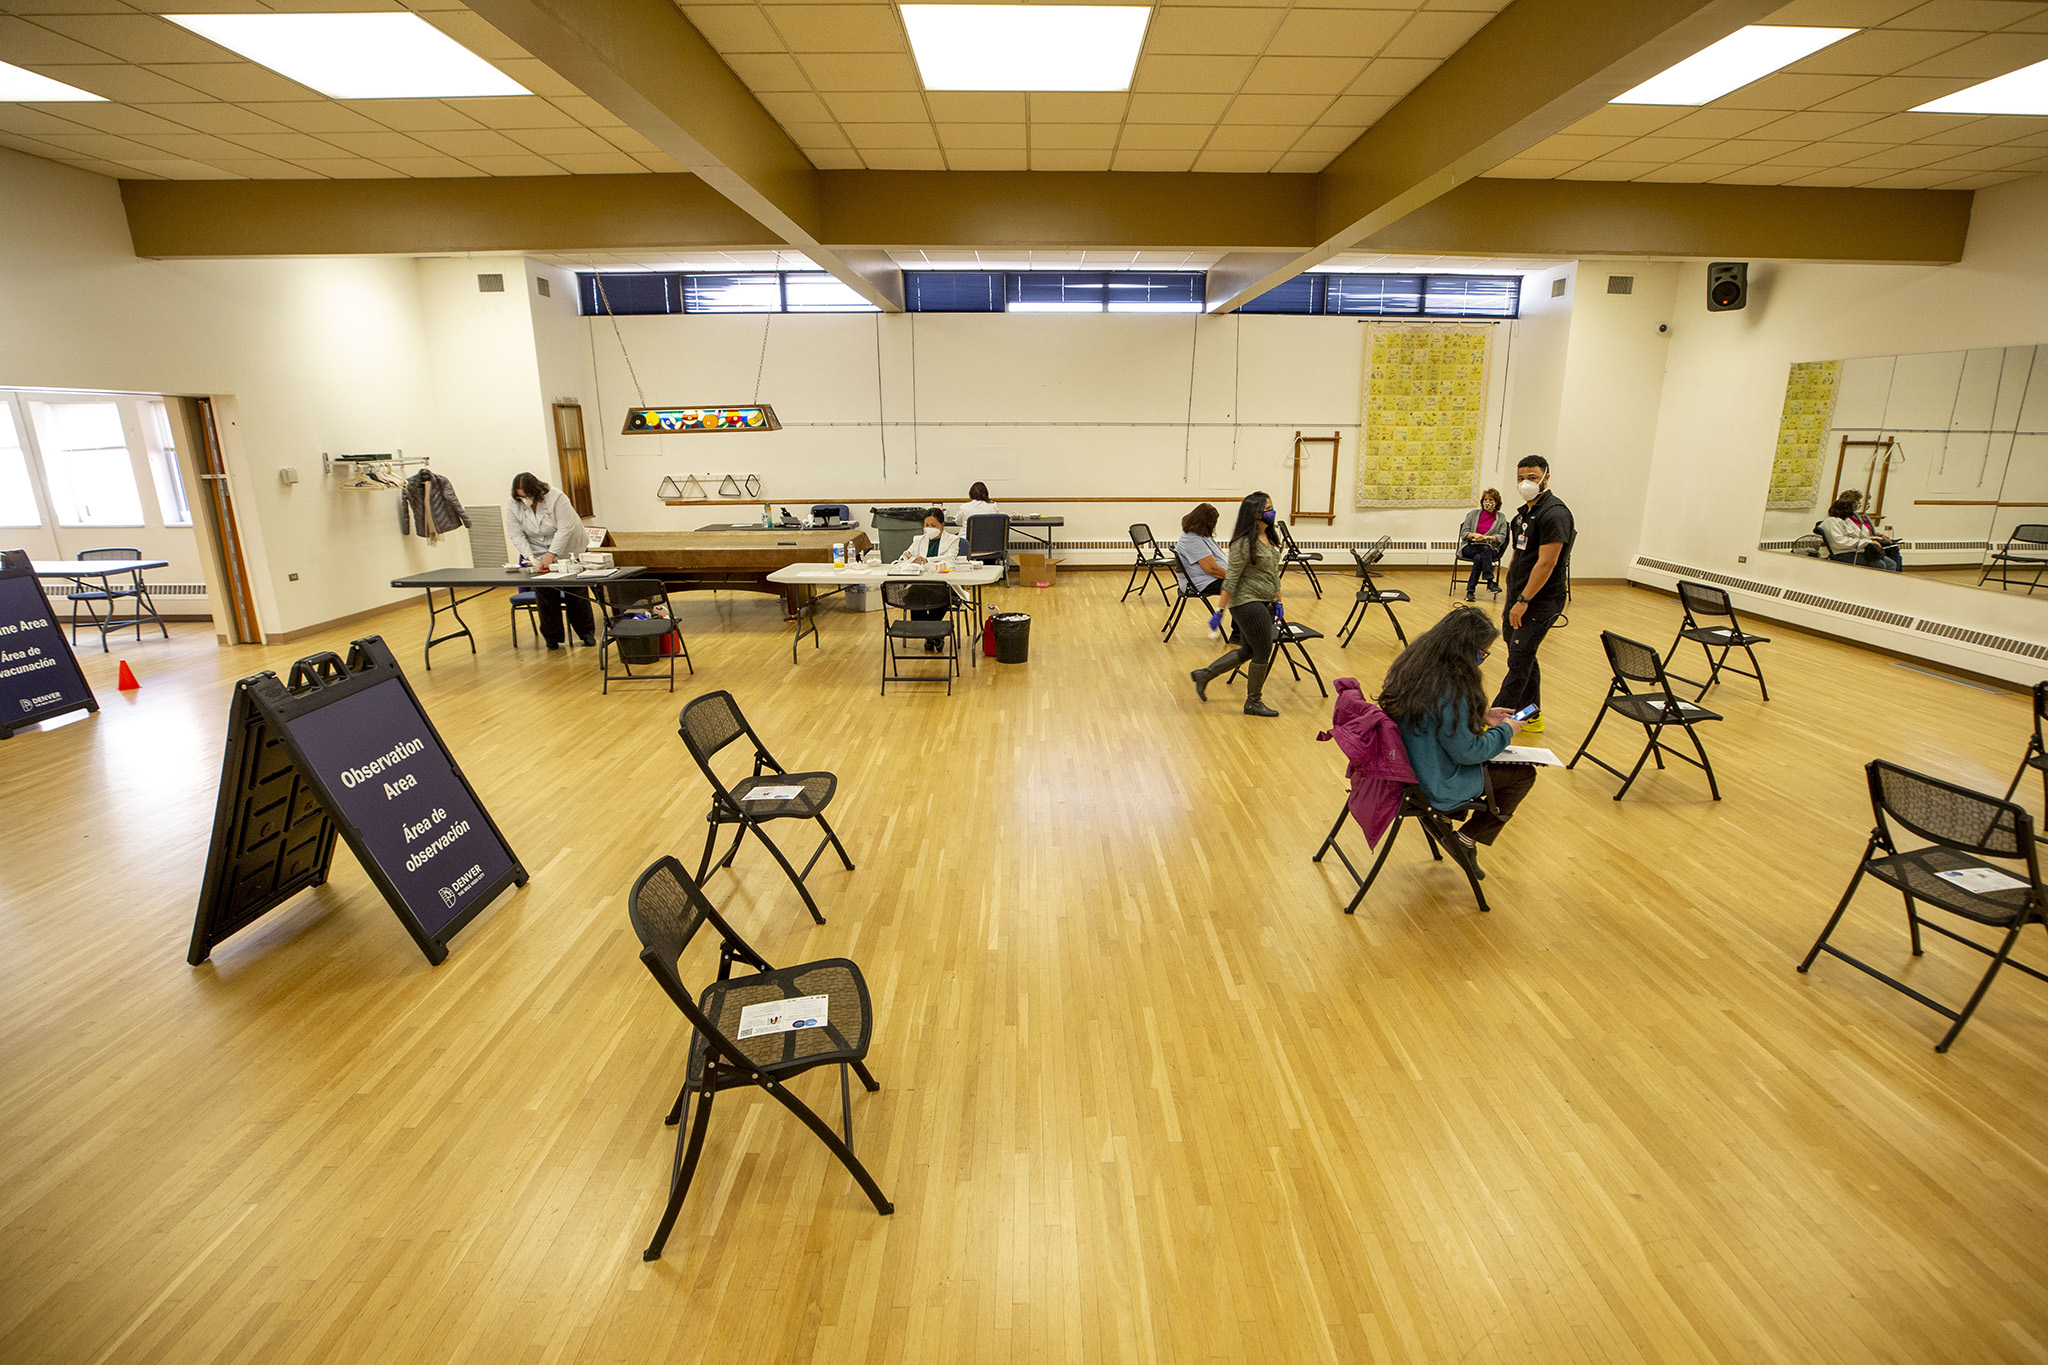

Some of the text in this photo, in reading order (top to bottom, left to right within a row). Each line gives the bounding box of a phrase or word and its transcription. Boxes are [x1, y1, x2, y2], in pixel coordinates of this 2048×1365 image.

[19, 618, 48, 631] Area
[1, 646, 41, 662] Área de
[31, 691, 61, 704] DENVER
[340, 737, 425, 789] Observation
[382, 773, 418, 800] Area
[402, 807, 447, 844] Área de
[405, 819, 471, 873] observación
[451, 864, 482, 892] DENVER
